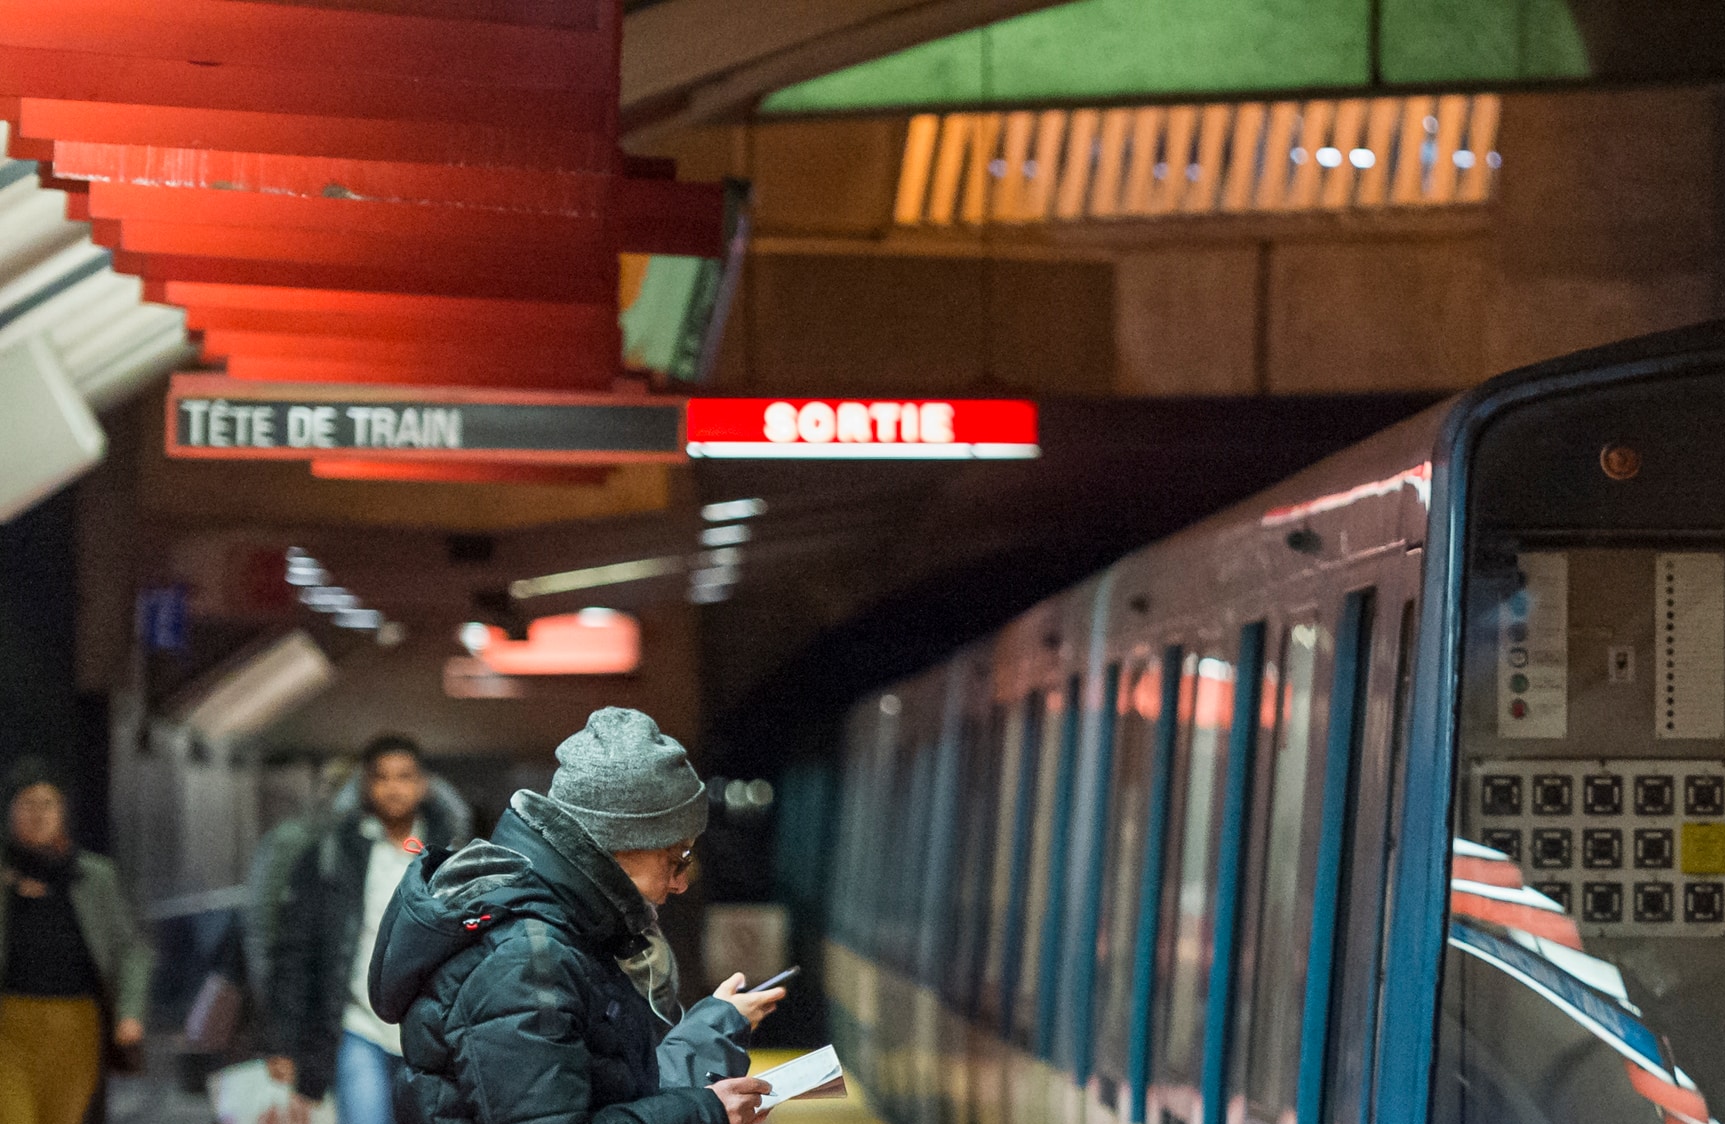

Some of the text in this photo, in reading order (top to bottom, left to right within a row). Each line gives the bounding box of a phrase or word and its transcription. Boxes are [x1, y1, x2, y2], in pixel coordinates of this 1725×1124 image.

[181, 398, 464, 449] TÊTE DE TRAIN
[763, 400, 955, 444] SORTIE
